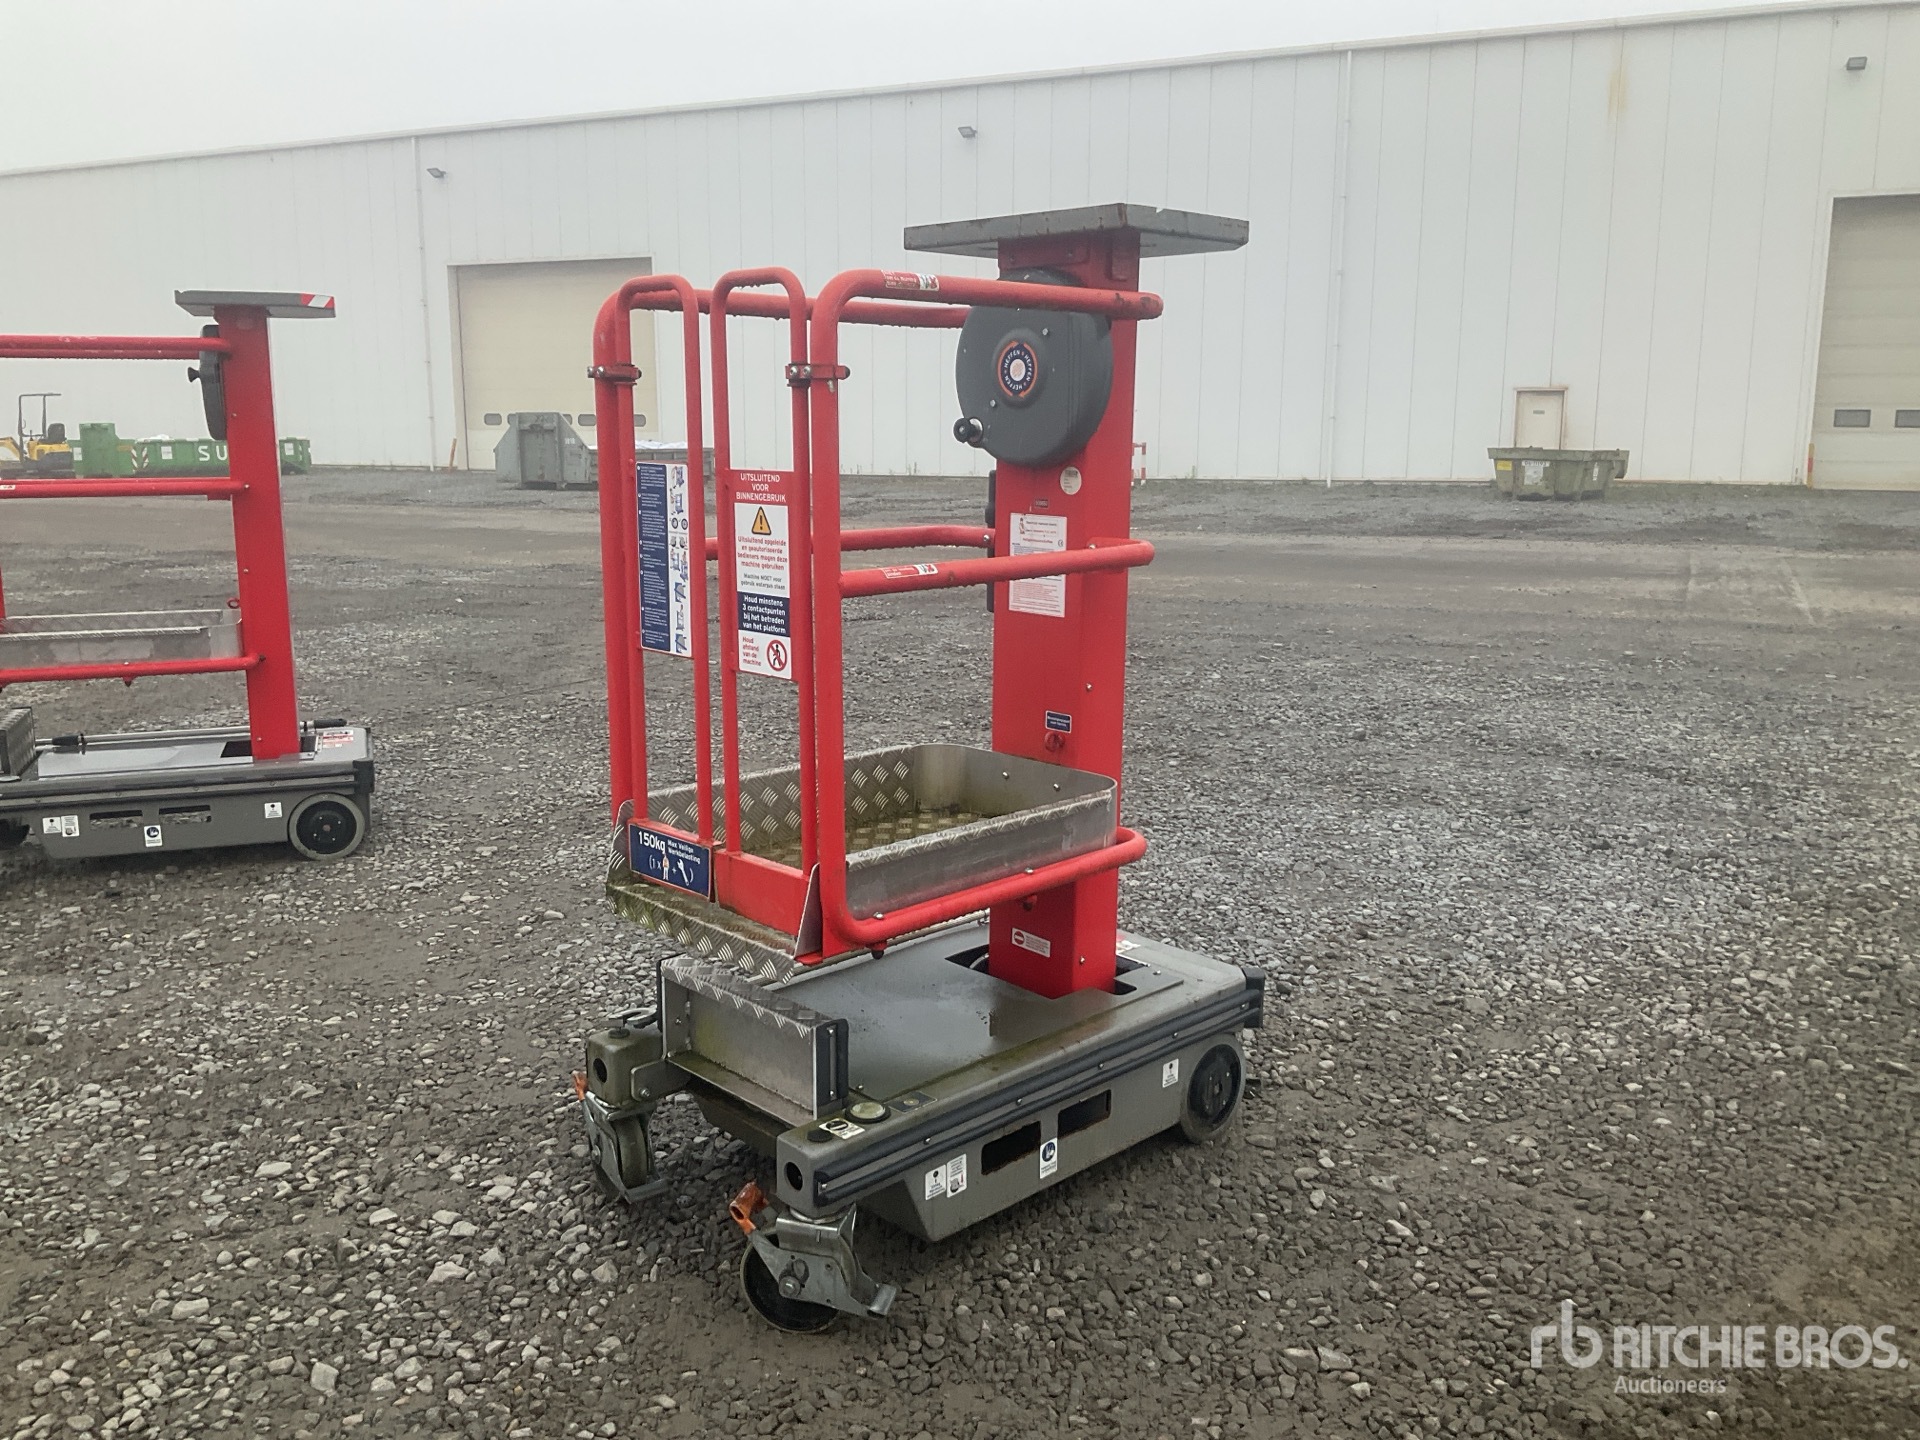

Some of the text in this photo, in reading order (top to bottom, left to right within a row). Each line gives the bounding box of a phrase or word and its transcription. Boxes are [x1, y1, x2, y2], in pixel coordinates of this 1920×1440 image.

[1004, 350, 1020, 368] HEFFEN
[740, 473, 780, 482] UITSLUITEND
[752, 483, 769, 491] VOOR
[736, 492, 786, 502] BINNENGEBRUIK
[738, 536, 764, 544] Uitsluitend
[737, 552, 759, 560] bedieners
[761, 563, 784, 571] gebruiken
[743, 595, 783, 607] Houd minstens
[742, 603, 786, 616] 3 contactpunten
[743, 613, 785, 625] bij het betreden
[742, 621, 786, 634] van het platform
[742, 636, 754, 644] Houd
[638, 830, 666, 855] 150kg
[667, 839, 677, 848] Max
[667, 847, 701, 865] Werkbelasting
